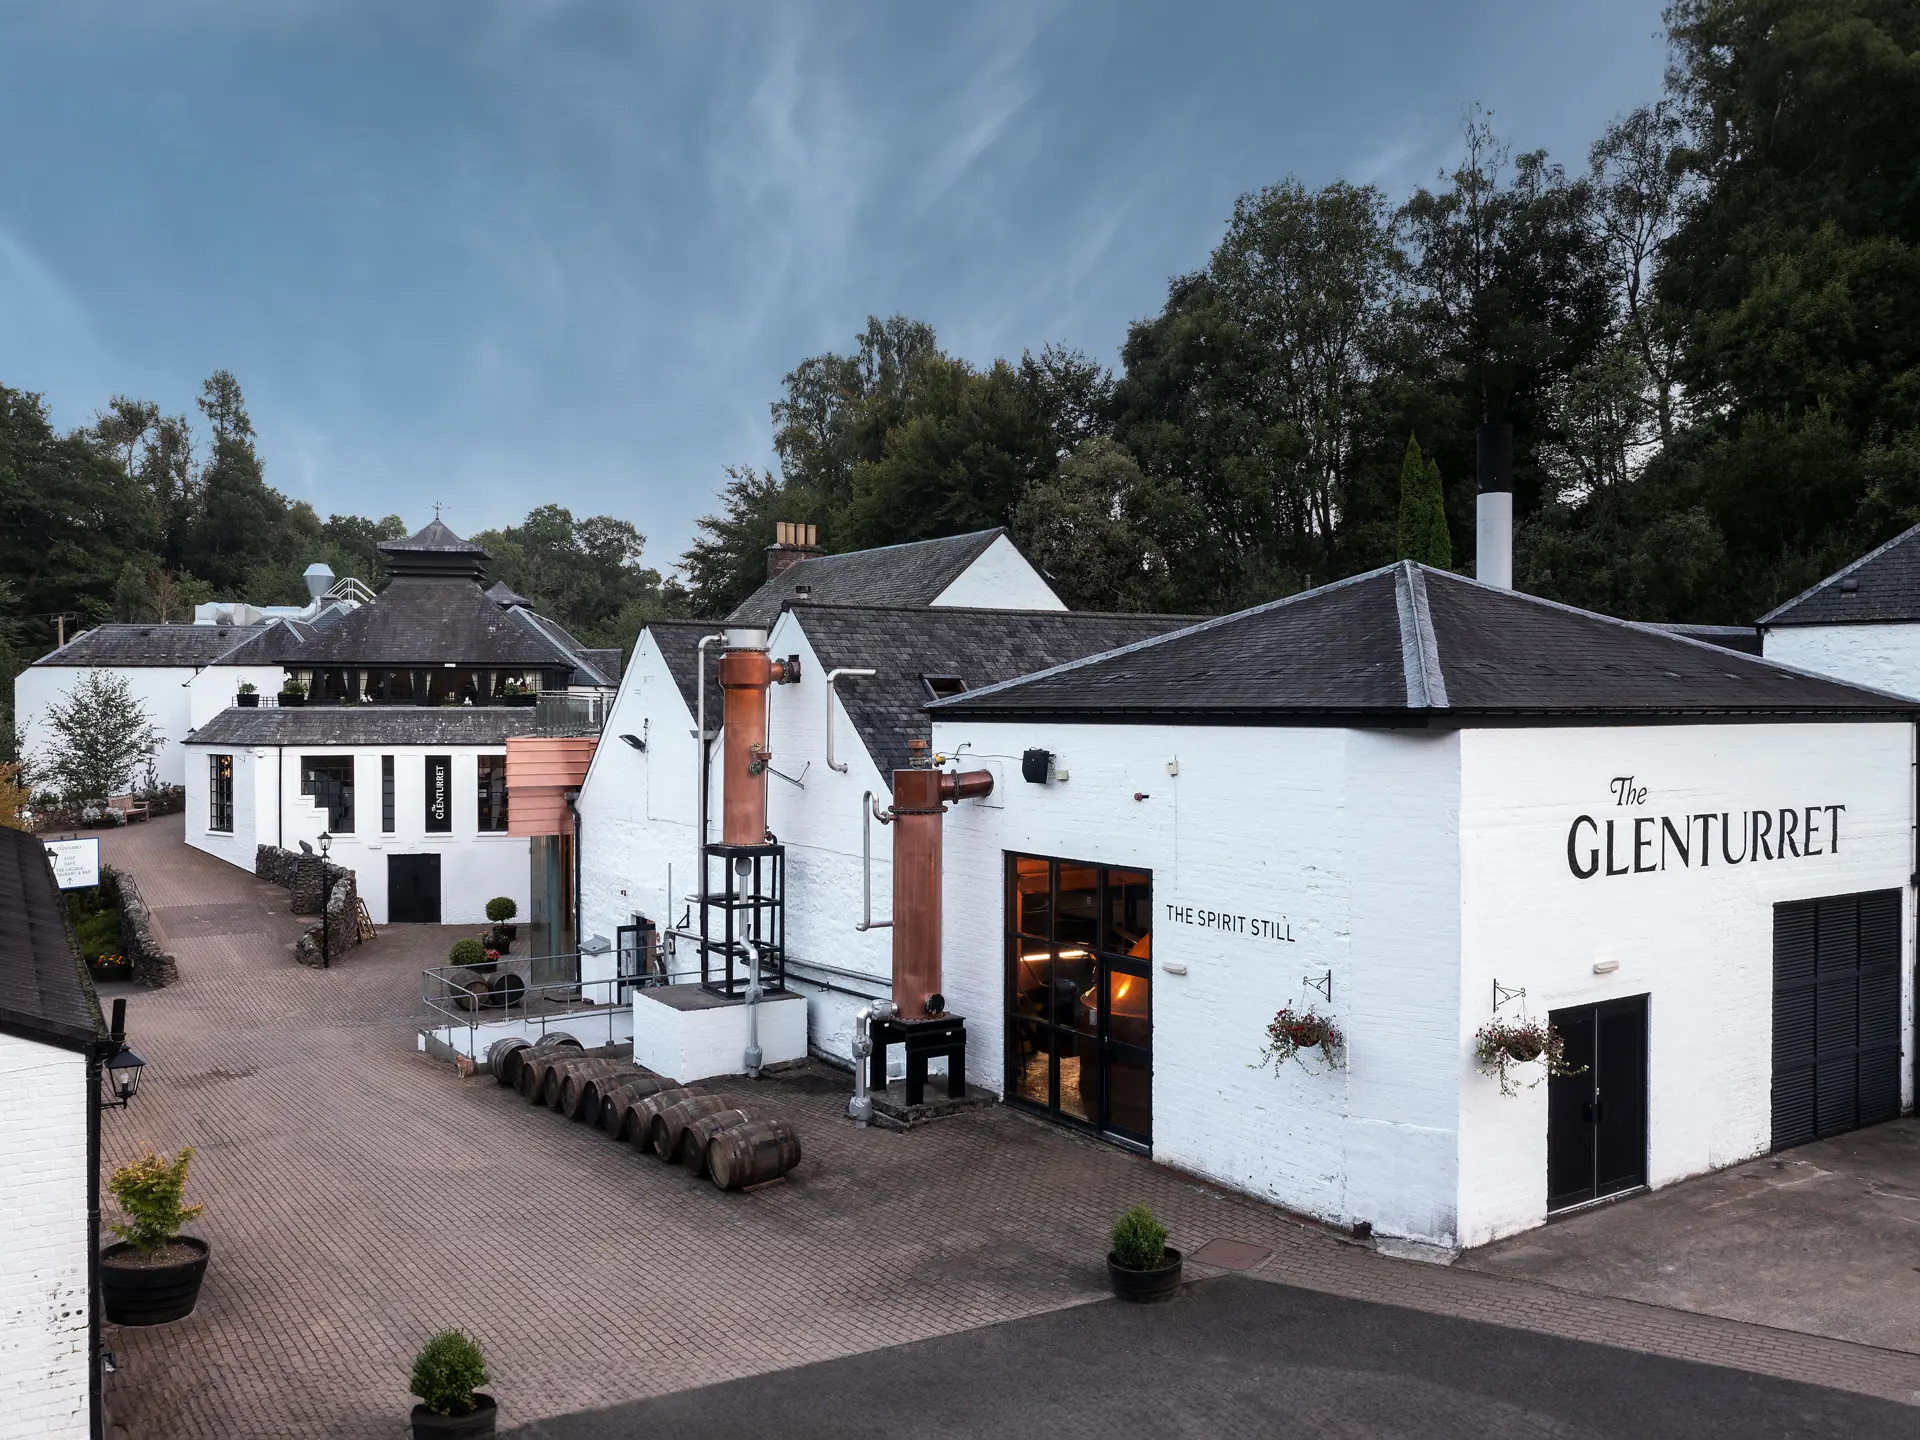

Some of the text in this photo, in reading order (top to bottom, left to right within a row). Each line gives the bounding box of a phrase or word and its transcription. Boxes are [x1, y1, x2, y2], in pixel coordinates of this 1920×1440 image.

[435, 765, 444, 819] GLENTURRET
[1610, 775, 1648, 806] The
[1567, 804, 1846, 880] GLENTURRET
[1166, 904, 1295, 942] THE SPIRIT STILL
